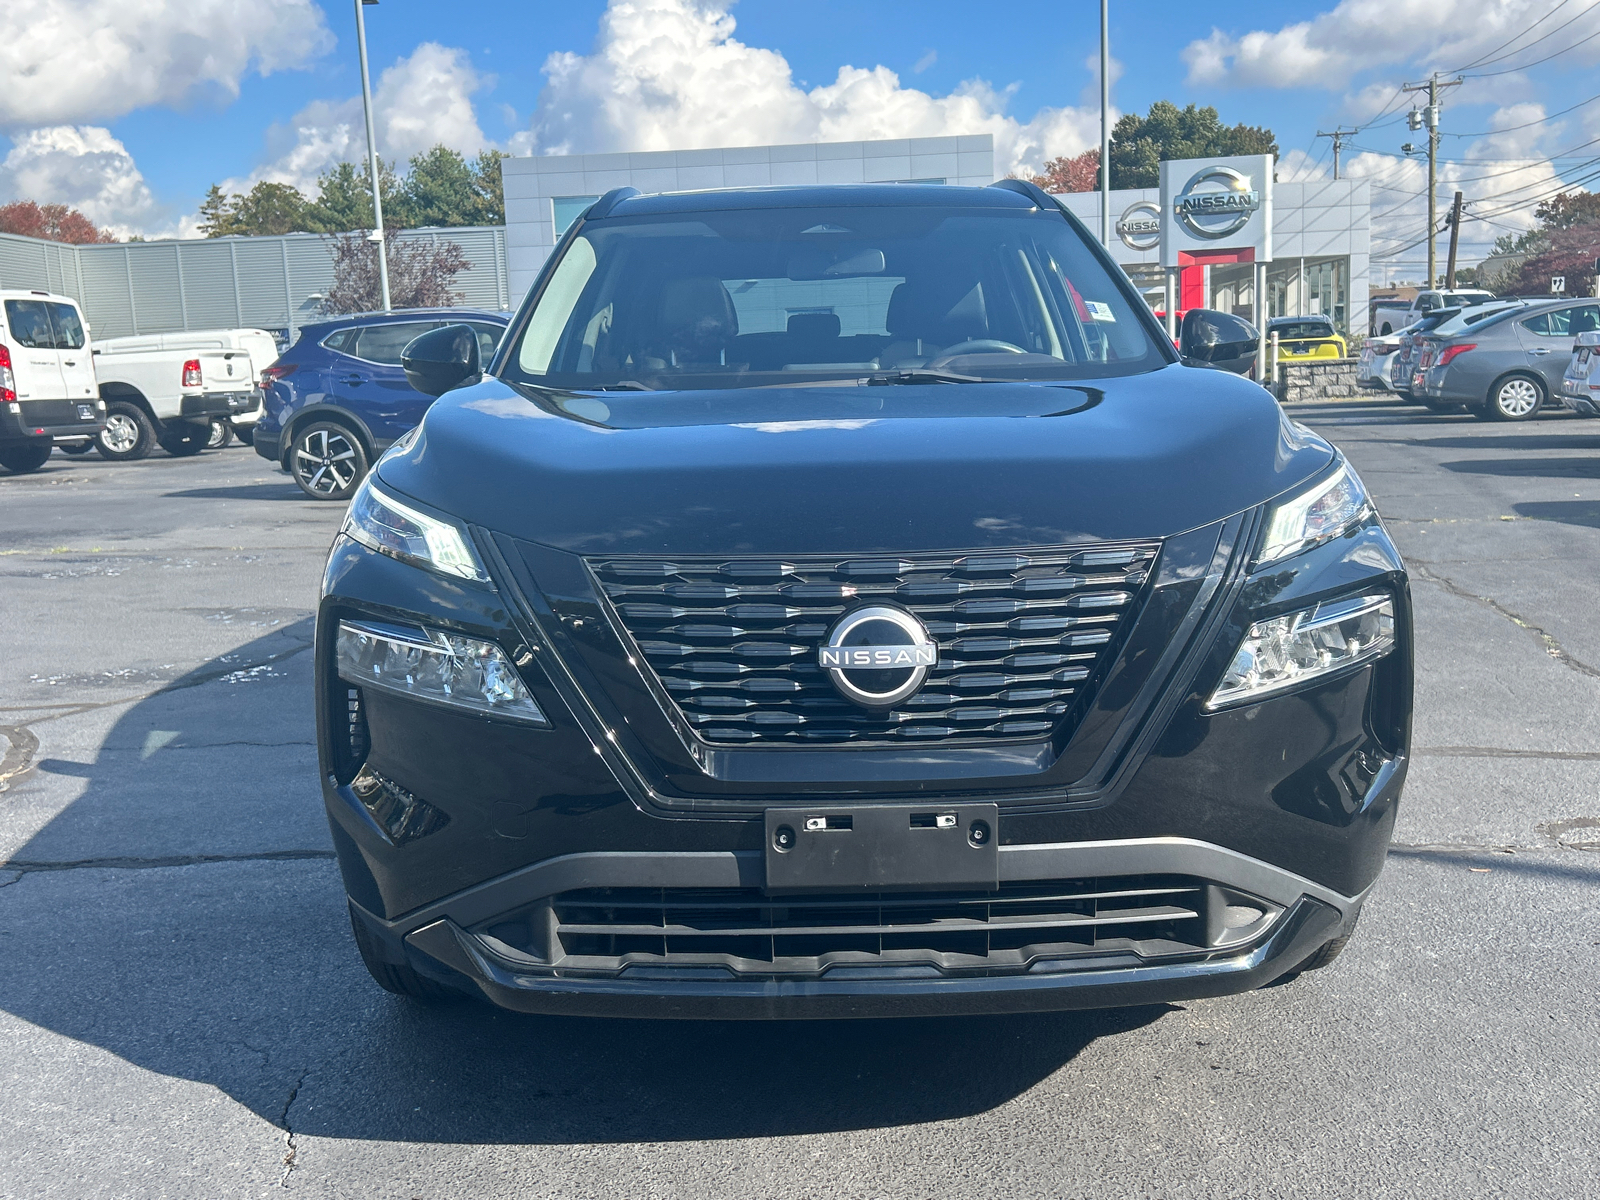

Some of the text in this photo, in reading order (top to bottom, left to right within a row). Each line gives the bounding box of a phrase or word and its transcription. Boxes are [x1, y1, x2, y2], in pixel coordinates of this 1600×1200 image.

[1183, 195, 1251, 210] NISSAN
[1121, 221, 1160, 231] NISSA
[822, 648, 932, 665] NISSAN
